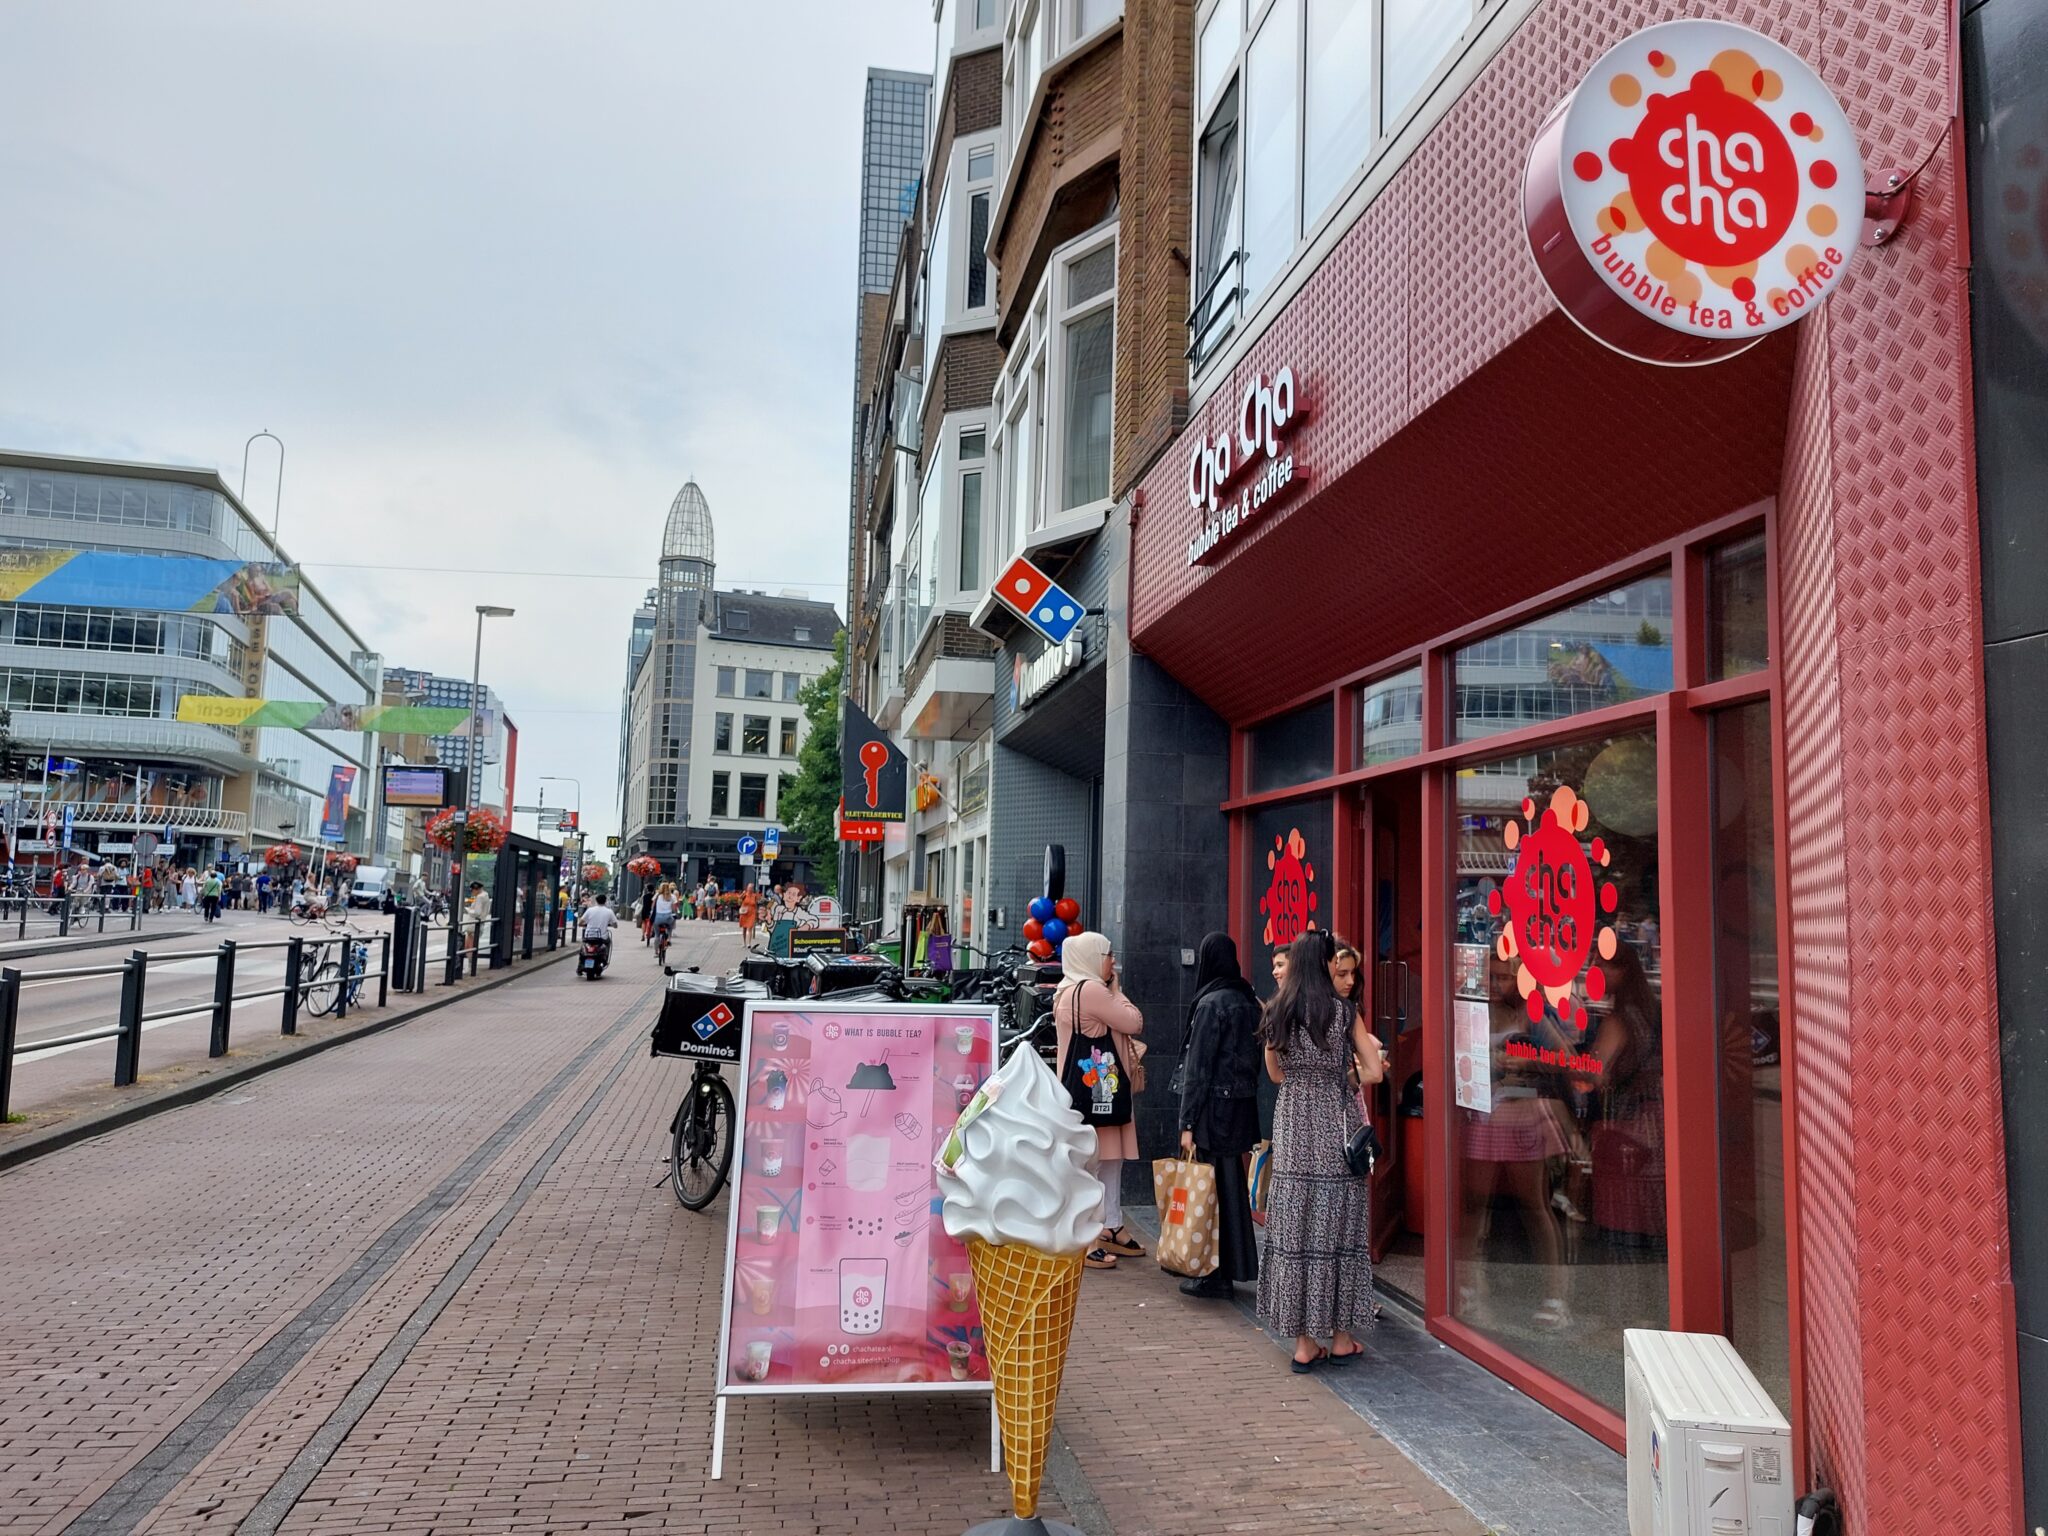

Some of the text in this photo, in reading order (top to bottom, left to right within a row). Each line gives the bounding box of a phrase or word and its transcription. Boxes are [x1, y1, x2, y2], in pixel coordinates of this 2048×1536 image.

[1658, 113, 1763, 188] cha
[1661, 183, 1766, 244] cha
[1591, 233, 1843, 330] bubble tea & coffee
[1188, 366, 1295, 512] Cha Cha
[1188, 455, 1292, 566] bubble tea & coffee
[1019, 630, 1073, 706] Dominos
[1525, 849, 1577, 914] cha
[1525, 912, 1577, 967] cha
[680, 1041, 735, 1058] Domino's
[844, 1028, 922, 1038] WHAT IS BUBBLE TEA?
